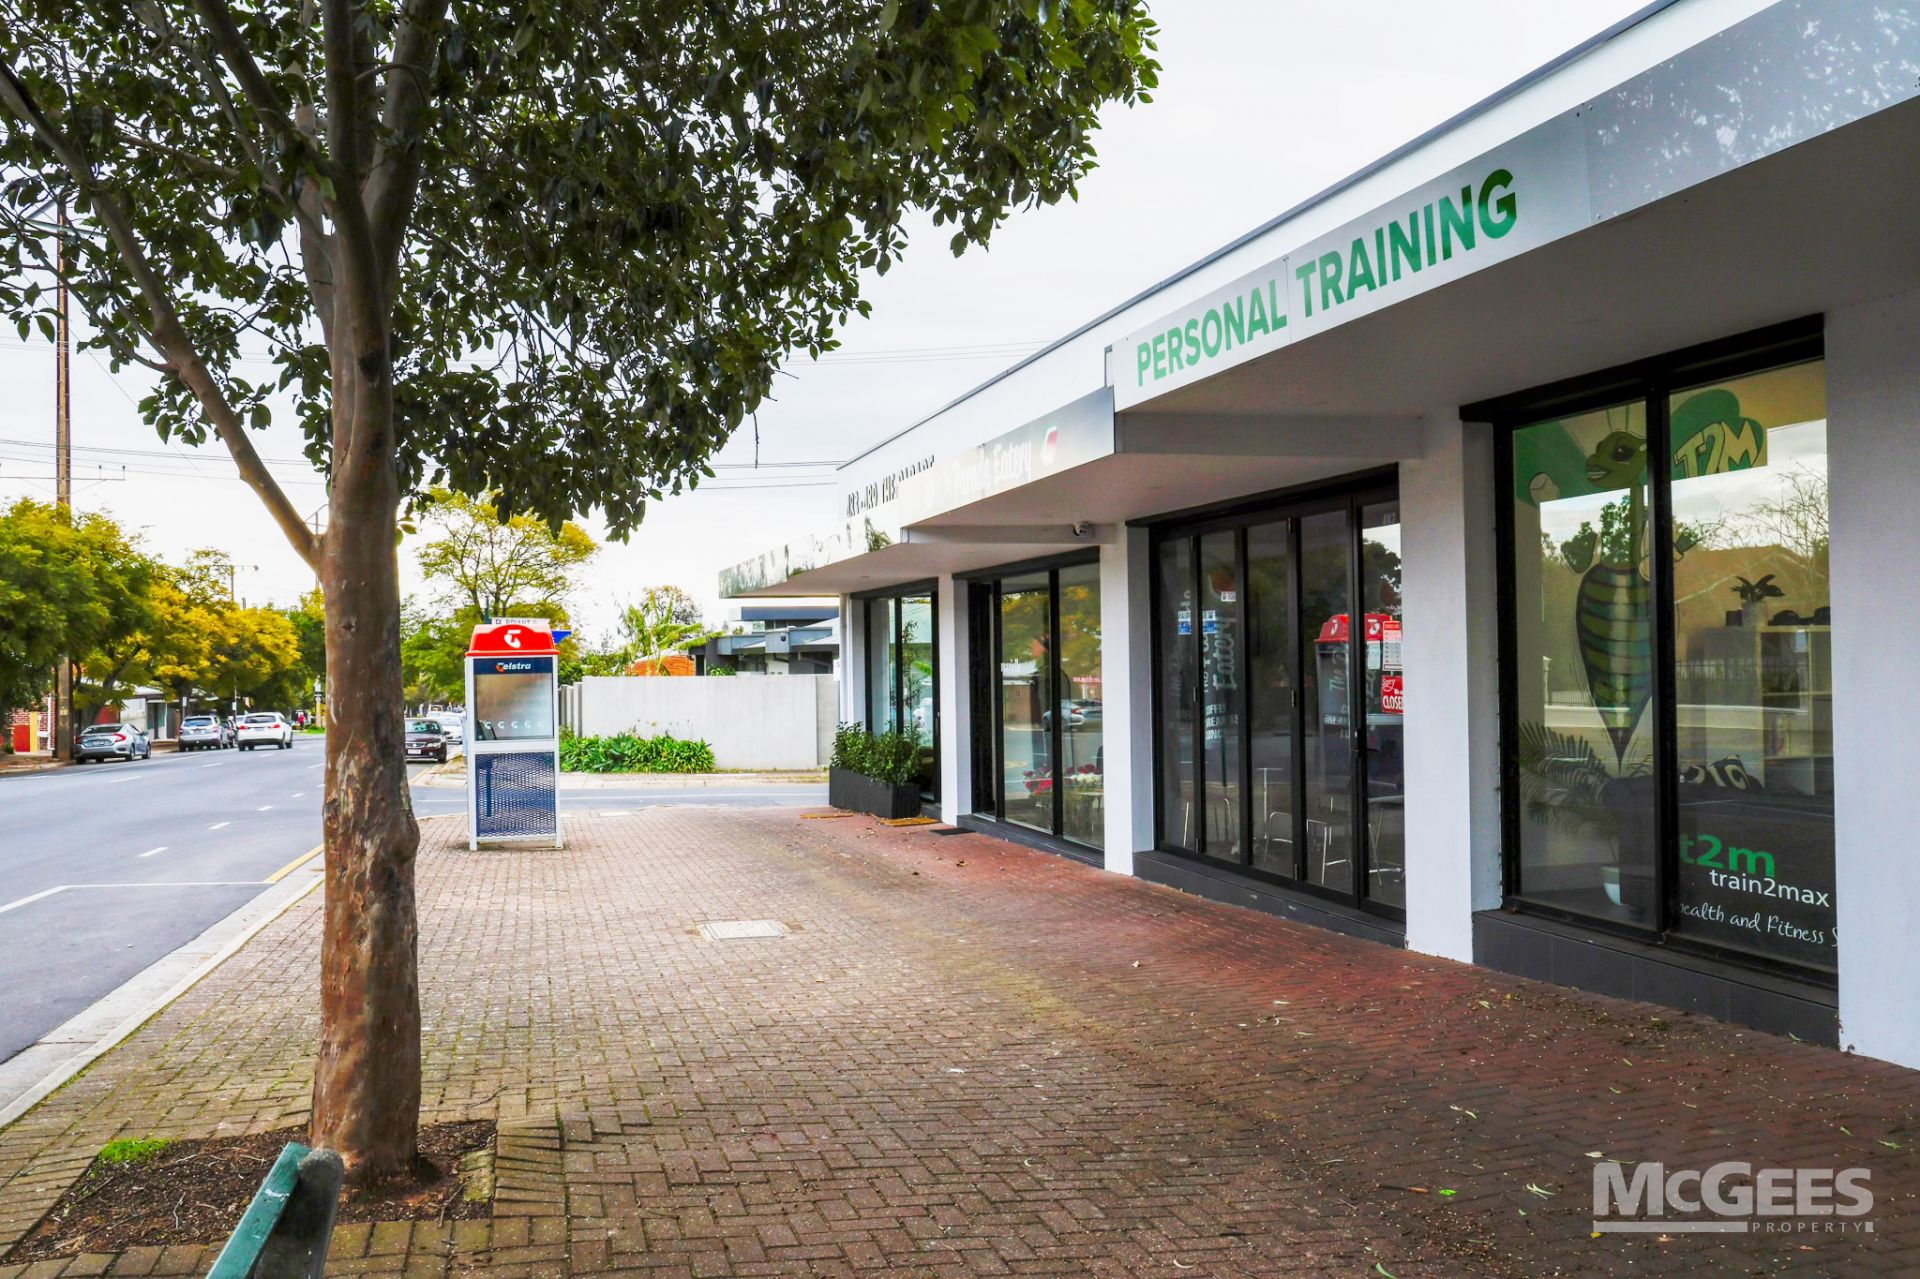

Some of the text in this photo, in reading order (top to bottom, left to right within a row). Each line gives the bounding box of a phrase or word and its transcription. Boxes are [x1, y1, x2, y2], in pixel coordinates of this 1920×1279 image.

[1137, 169, 1518, 387] PERSONAL TRAINING
[495, 662, 532, 673] Telstra
[1382, 695, 1403, 710] CLOSE
[1680, 834, 1776, 879] t2m
[1709, 868, 1830, 908] train2max
[1730, 912, 1761, 932] and
[1767, 915, 1824, 944] Fitness
